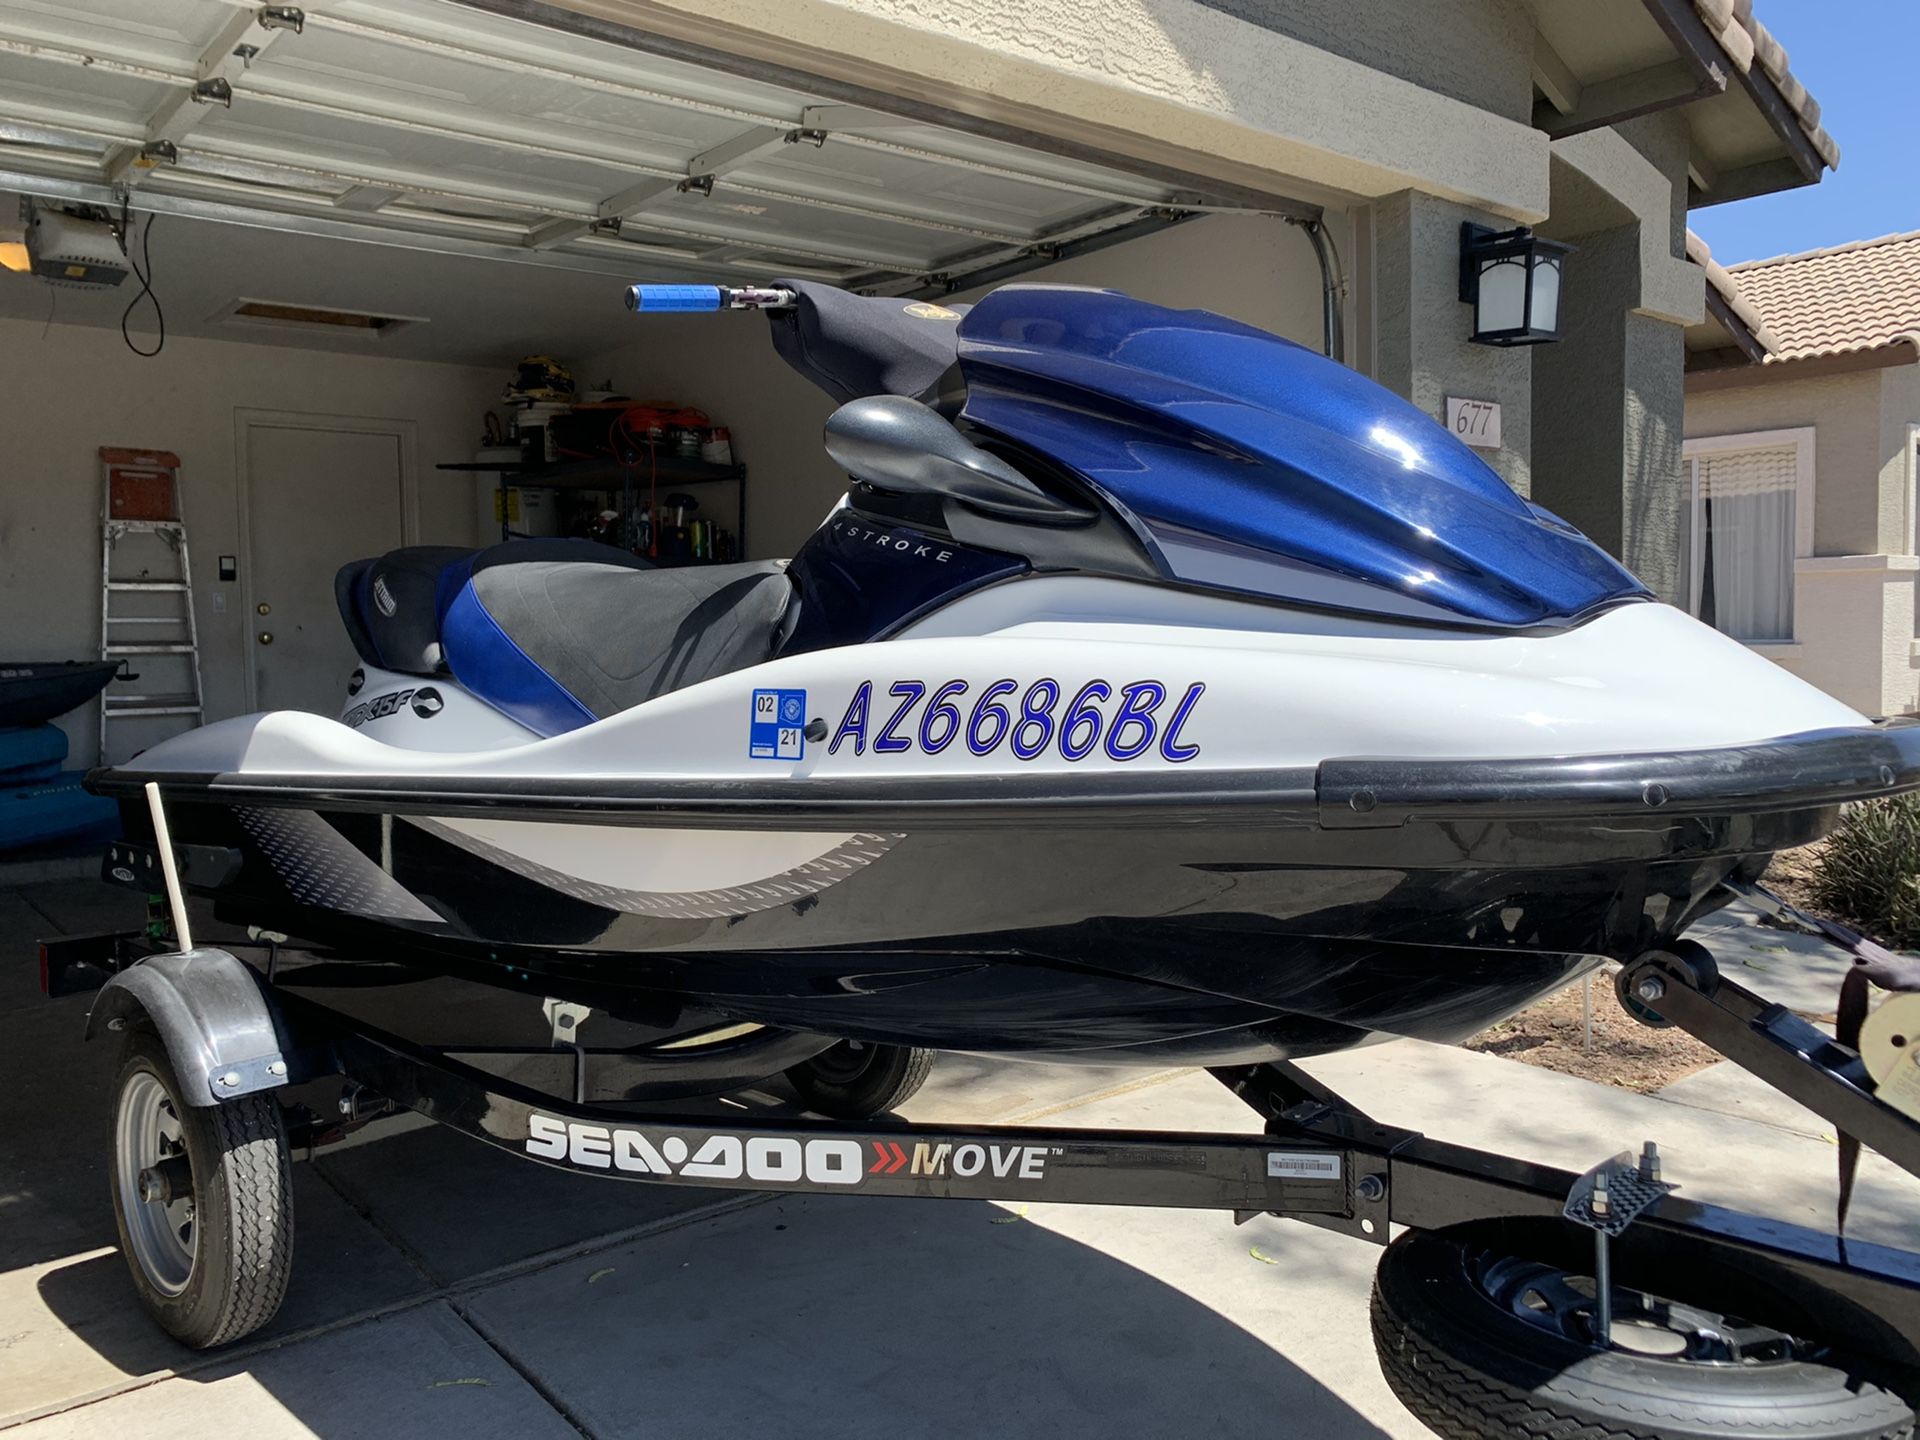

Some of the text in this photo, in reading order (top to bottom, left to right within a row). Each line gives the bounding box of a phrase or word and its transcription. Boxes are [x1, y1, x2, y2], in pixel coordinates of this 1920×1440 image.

[1457, 402, 1493, 435] 677
[833, 522, 953, 563] 4 STROKE
[757, 696, 774, 713] 02
[828, 678, 1206, 763] AZ6686BL
[780, 729, 797, 746] 21
